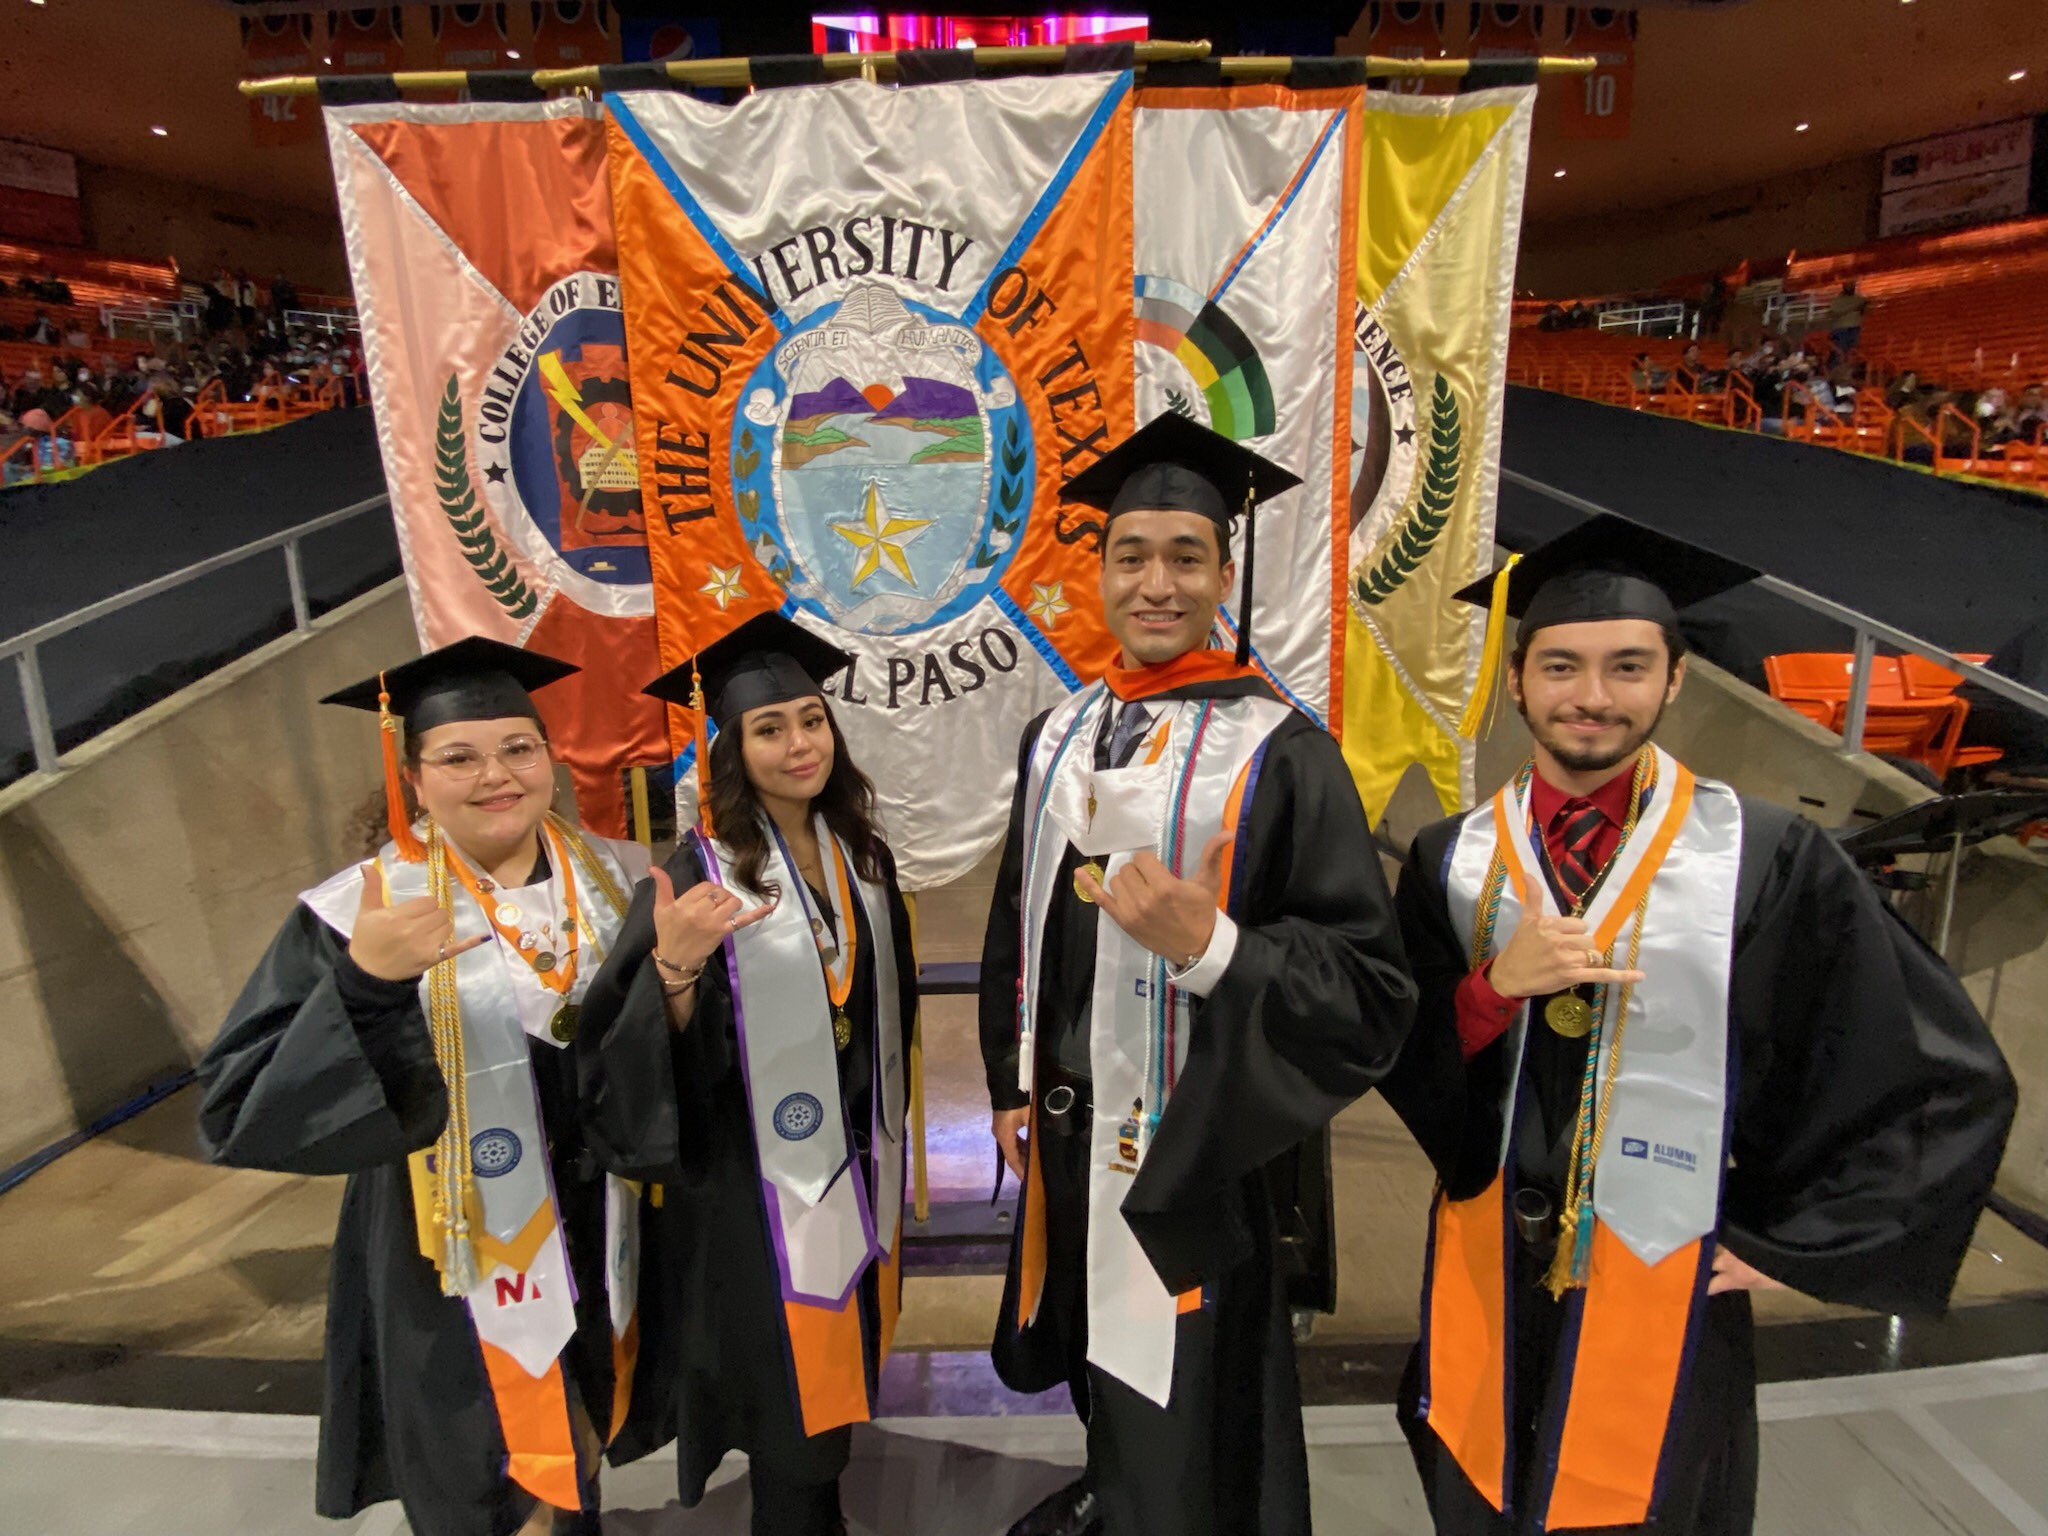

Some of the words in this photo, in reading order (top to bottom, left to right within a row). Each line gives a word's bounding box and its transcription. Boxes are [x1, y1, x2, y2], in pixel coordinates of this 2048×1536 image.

[1584, 74, 1616, 117] 10
[664, 216, 974, 398] UNIVERSITY
[987, 267, 1057, 339] OF
[479, 309, 550, 443] COLLEGE
[549, 279, 581, 315] OF
[596, 279, 624, 309] E
[778, 331, 827, 371] SCIENTIA
[832, 331, 847, 346] ET
[901, 327, 978, 353] HUMANITAS
[1355, 302, 1413, 404] IENCE
[655, 420, 716, 536] THE
[1037, 339, 1110, 553] TEXS
[822, 652, 867, 705] L
[887, 628, 1018, 709] PASO
[1653, 1142, 1697, 1165] ALUMNI
